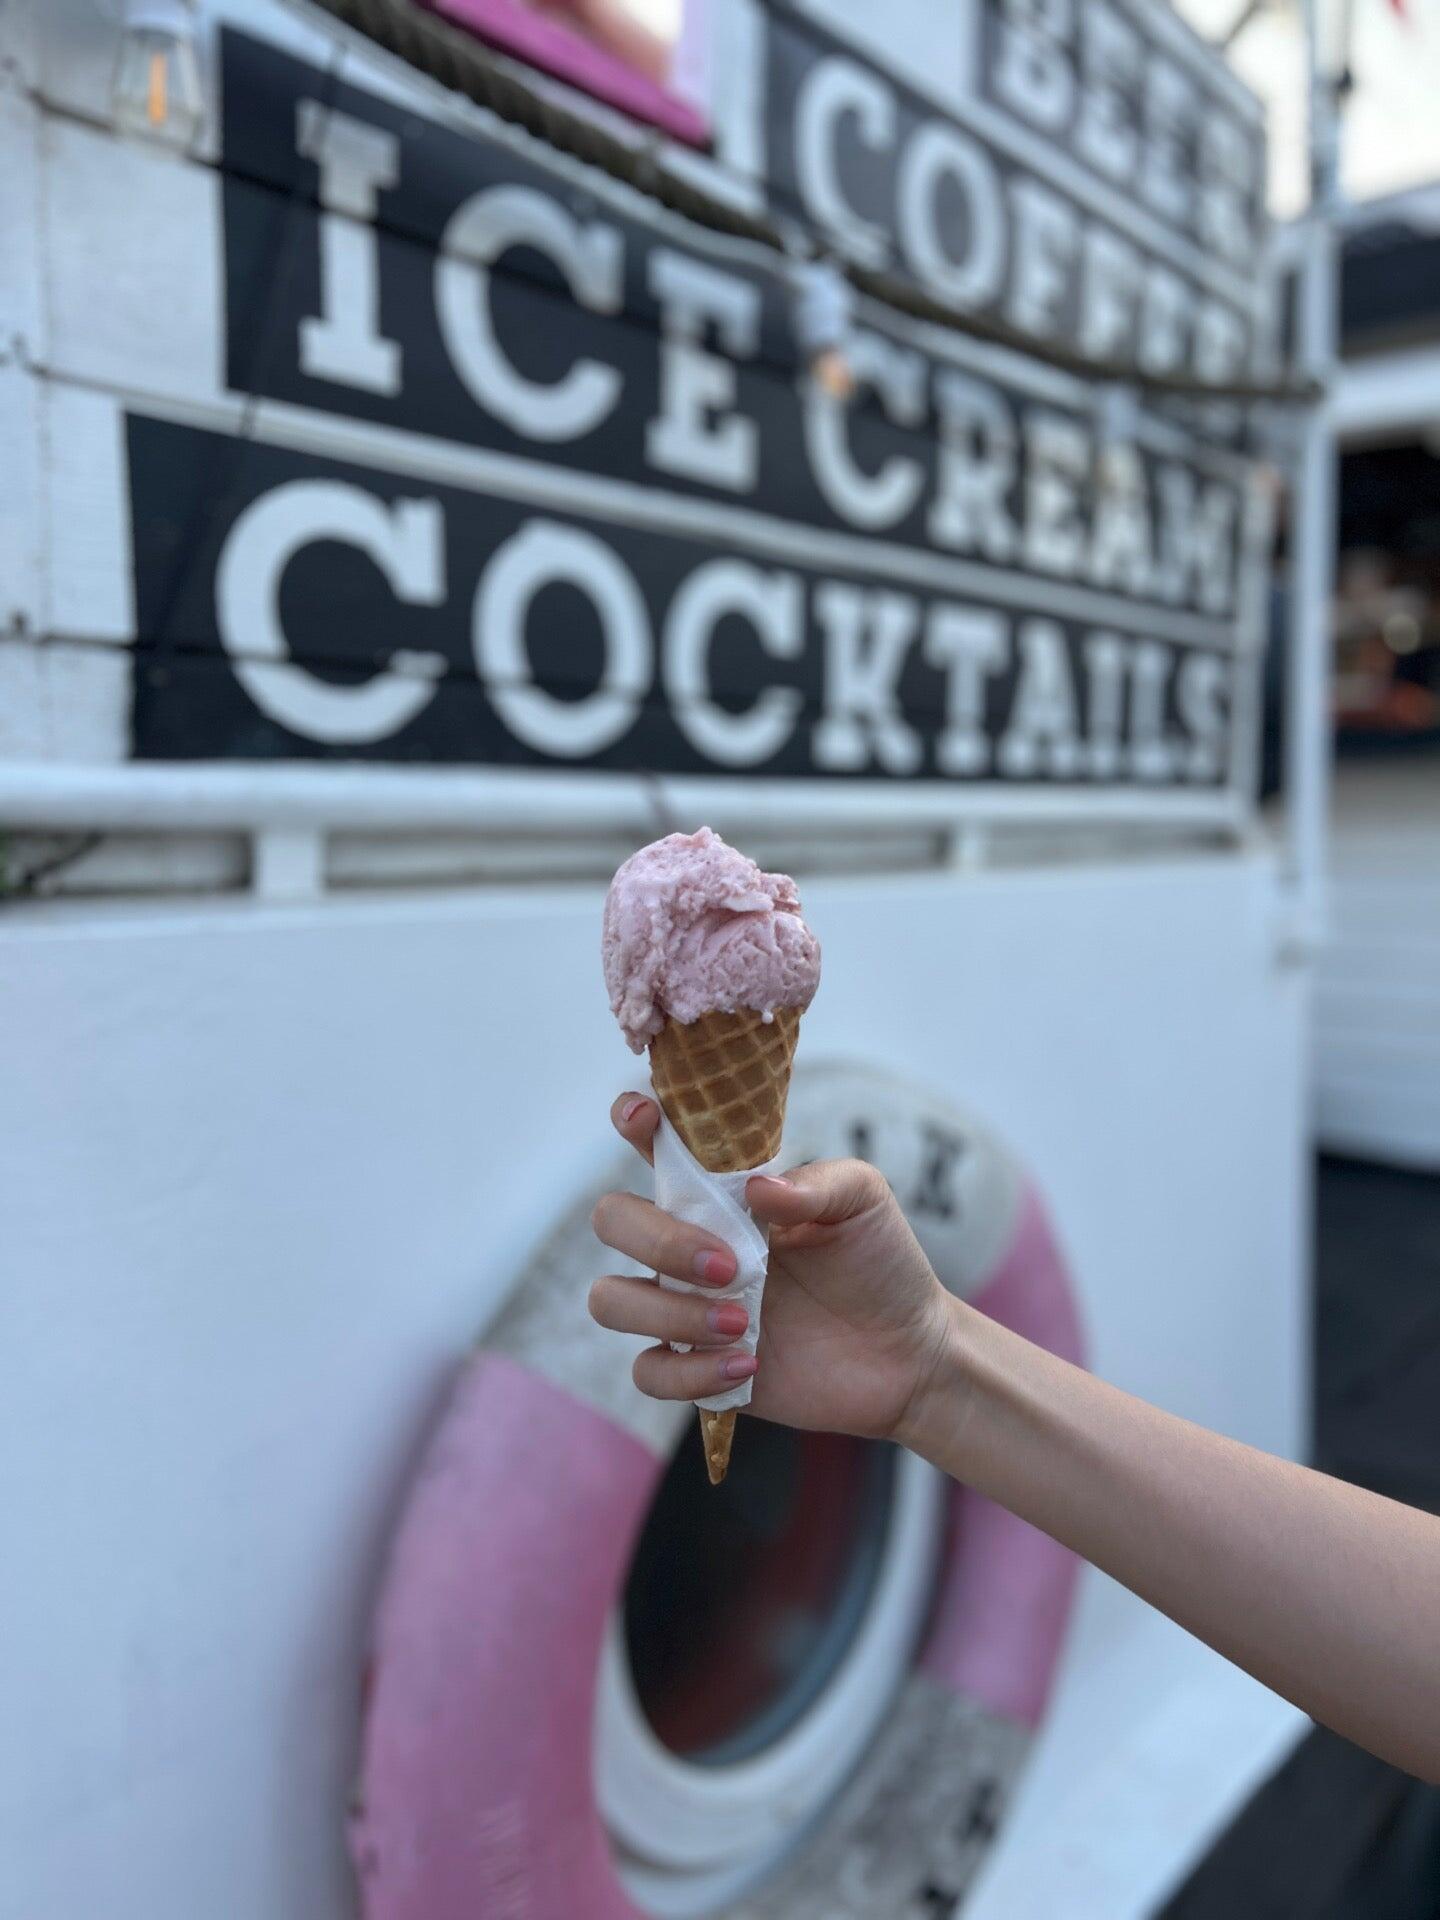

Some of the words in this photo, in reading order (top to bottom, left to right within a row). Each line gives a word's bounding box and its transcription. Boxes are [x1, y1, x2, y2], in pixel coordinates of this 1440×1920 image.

[297, 100, 760, 492] ICE
[804, 325, 1236, 616] CREAM
[215, 478, 1233, 782] COCKTAILS
